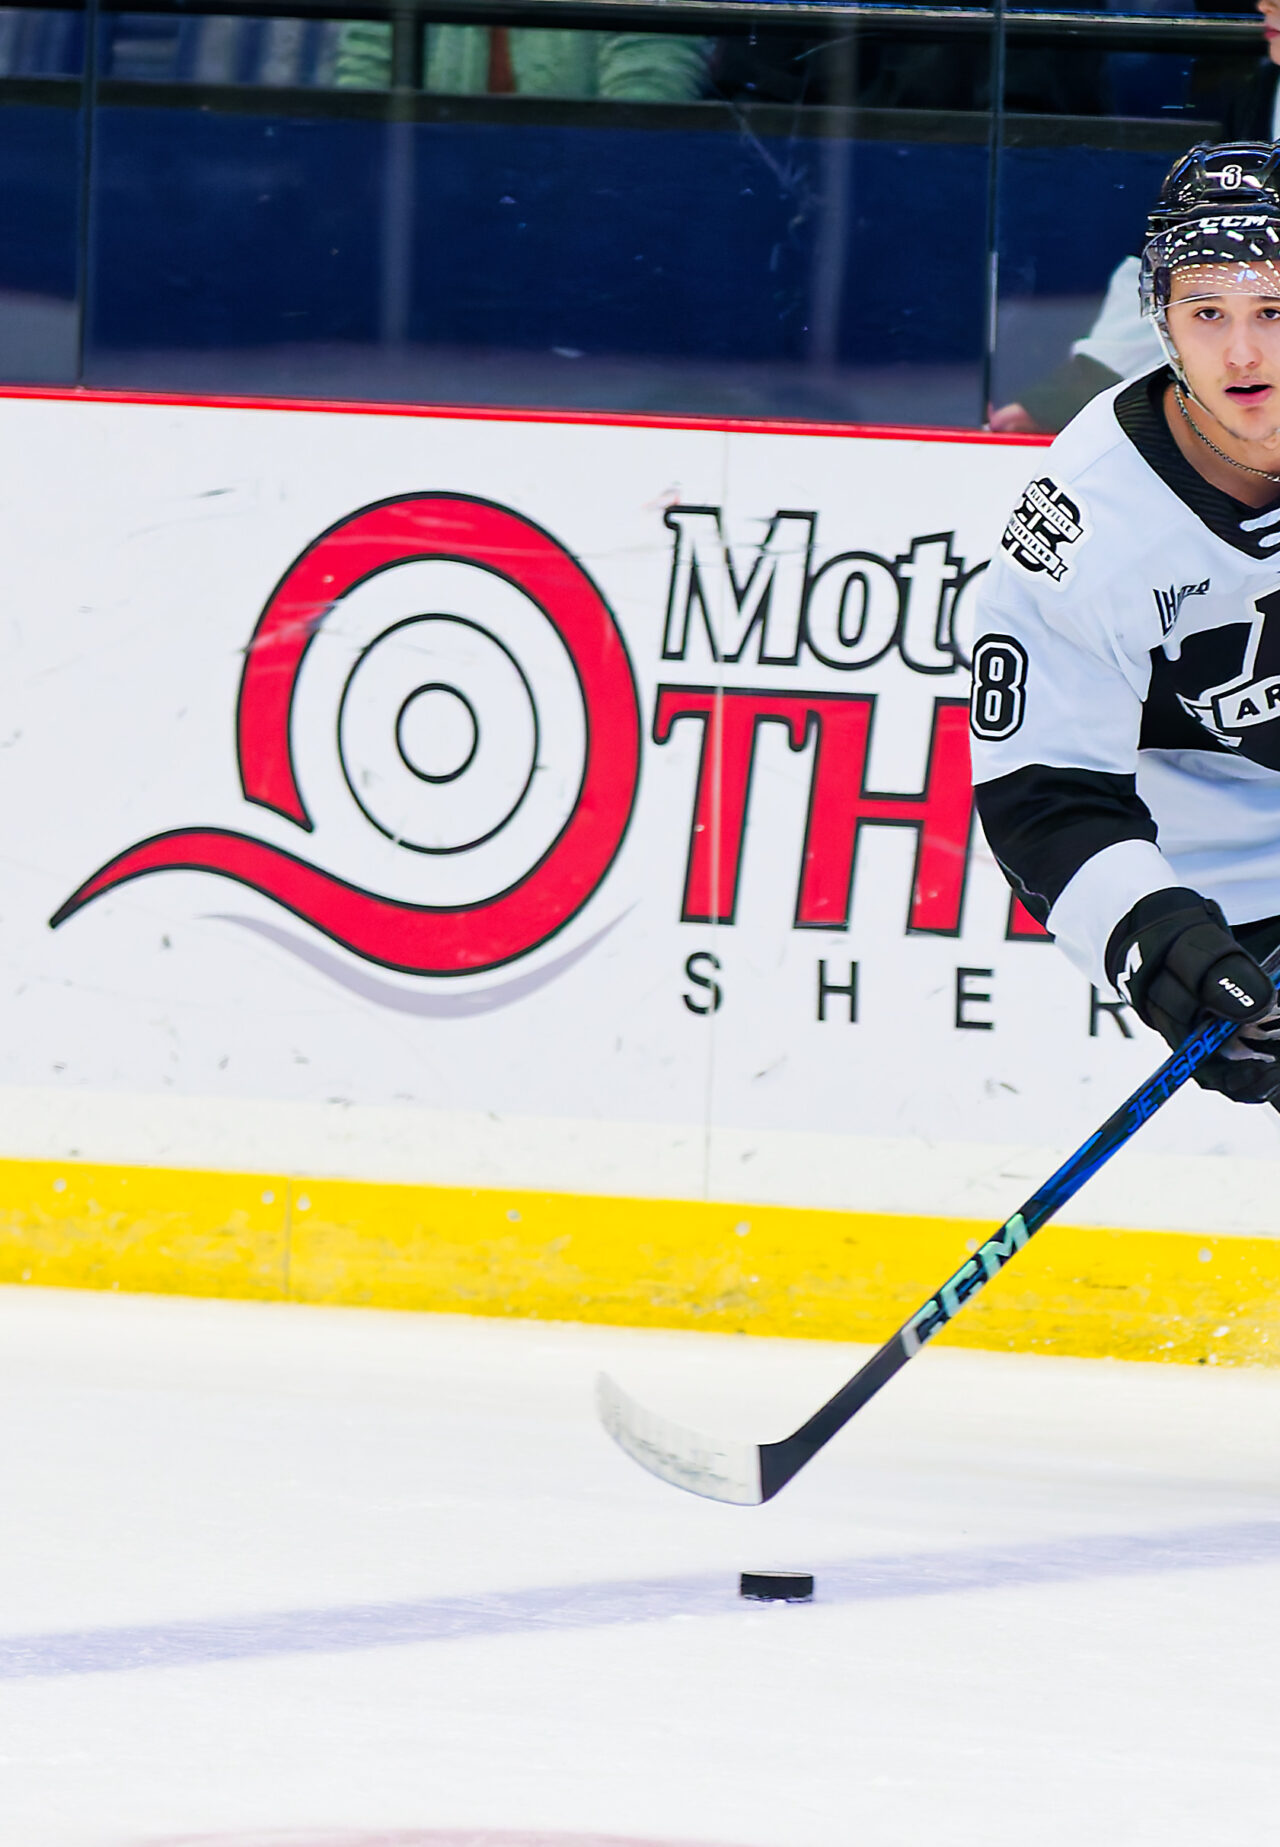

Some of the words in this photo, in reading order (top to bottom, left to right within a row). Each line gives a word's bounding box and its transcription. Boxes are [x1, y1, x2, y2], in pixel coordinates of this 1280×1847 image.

[1199, 215, 1269, 229] CCM
[663, 506, 992, 674] Mot
[970, 633, 1028, 741] 8
[1208, 977, 1255, 1008] CCM
[900, 1212, 1031, 1358] CCM
